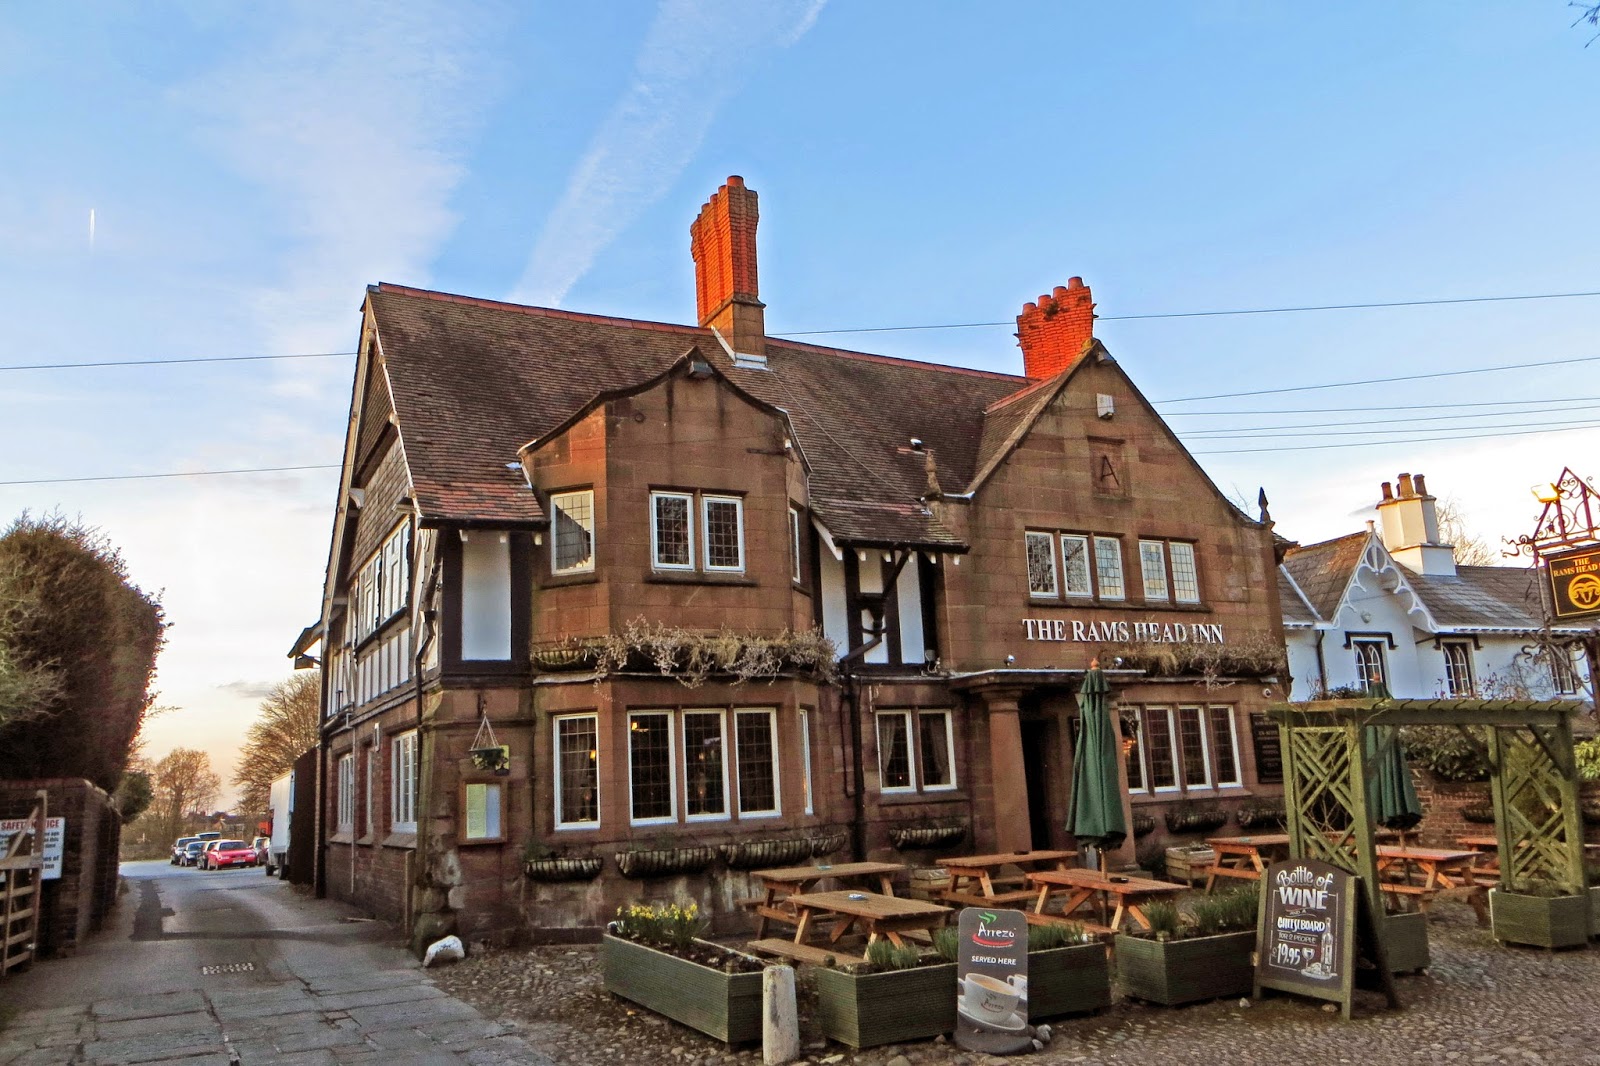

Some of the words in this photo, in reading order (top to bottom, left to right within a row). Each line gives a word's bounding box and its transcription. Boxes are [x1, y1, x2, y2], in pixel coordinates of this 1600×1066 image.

[1573, 558, 1590, 566] THE
[1553, 567, 1576, 577] RAMS
[1576, 563, 1598, 573] HEAD
[1022, 618, 1067, 641] THE
[1071, 620, 1130, 643] RAMS
[1133, 622, 1187, 643] HEAD
[1191, 623, 1224, 644] INN
[1, 821, 27, 830] SAFET
[32, 819, 60, 829] NICE
[1277, 866, 1314, 886] Bottle
[1316, 873, 1333, 890] of
[1279, 887, 1328, 909] WINE
[978, 922, 1015, 937] Arrezo
[1289, 933, 1294, 941] 2
[1294, 935, 1317, 944] PEOPLE
[971, 955, 997, 964] SERVED
[997, 957, 1017, 966] HERE
[1277, 943, 1301, 966] 19.95
